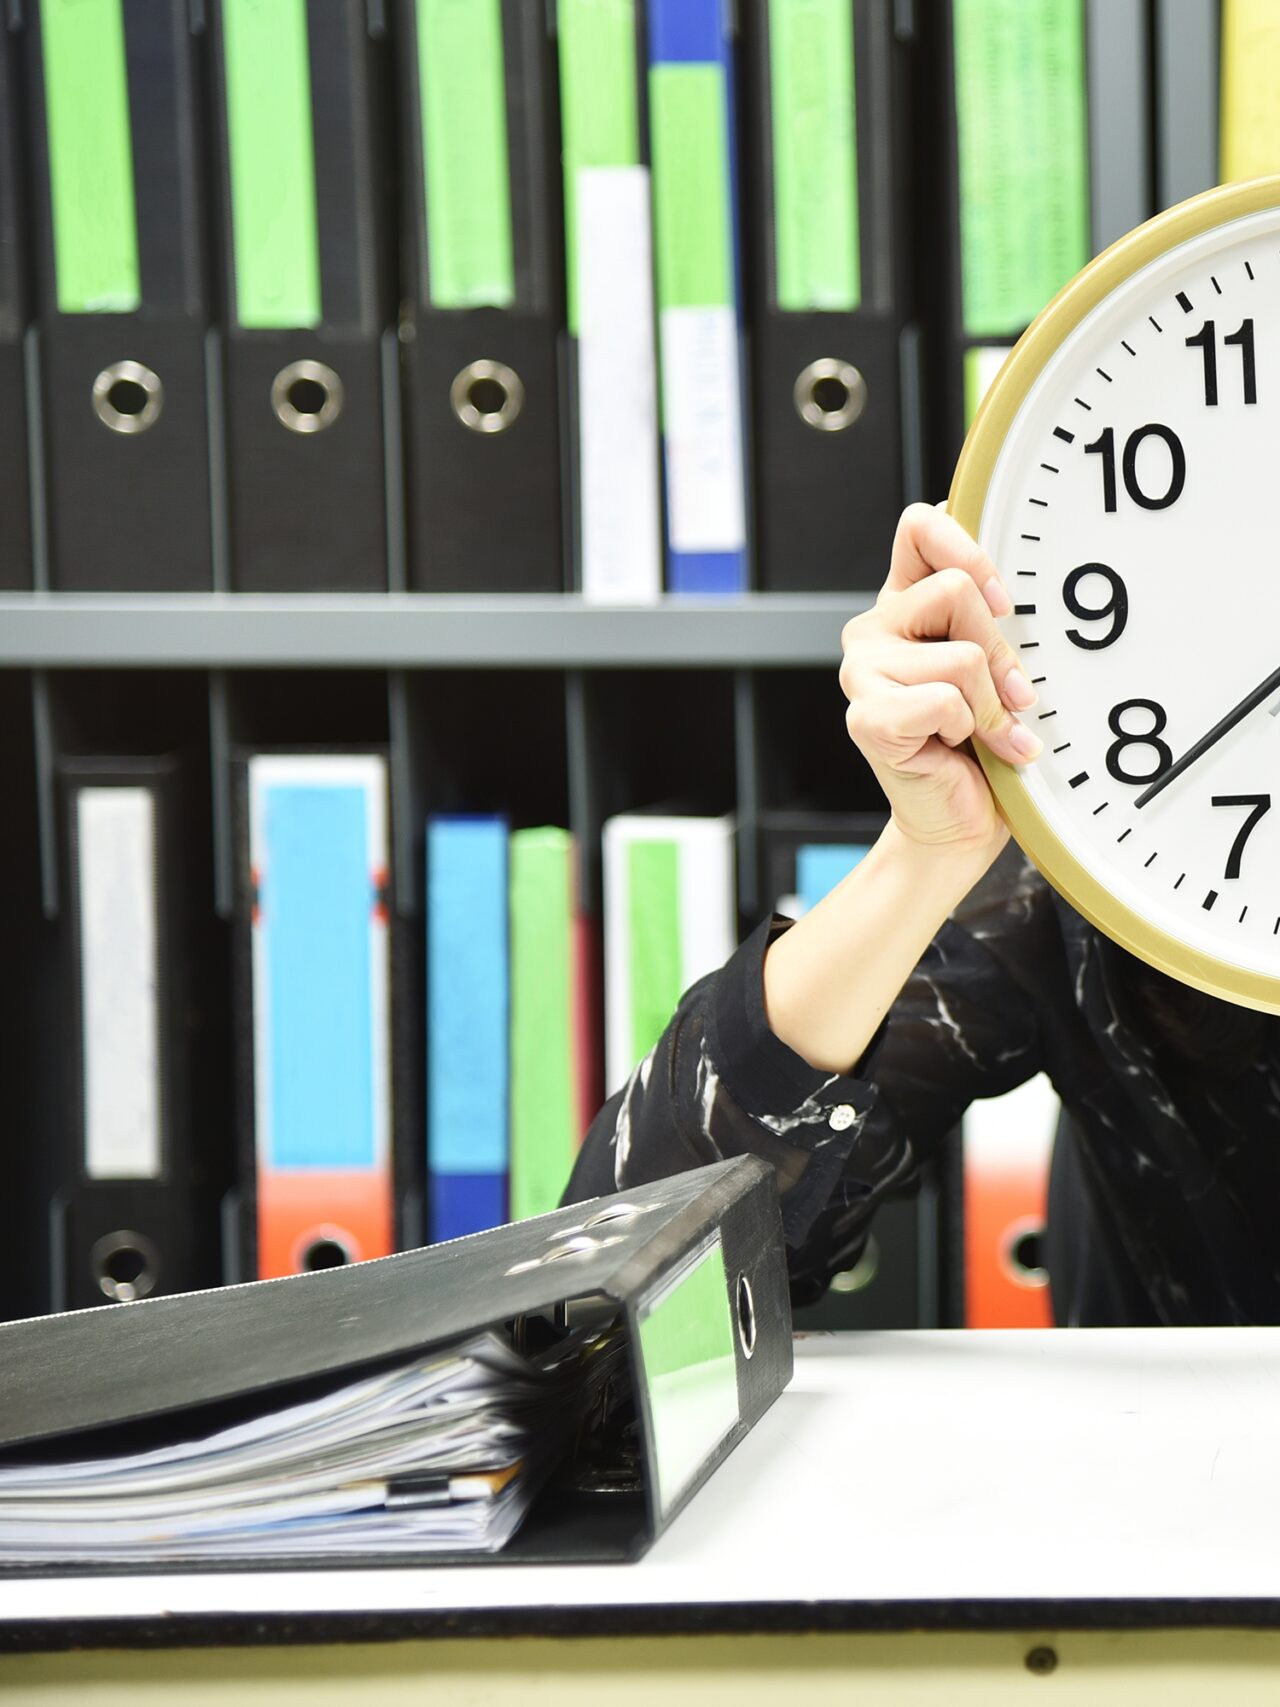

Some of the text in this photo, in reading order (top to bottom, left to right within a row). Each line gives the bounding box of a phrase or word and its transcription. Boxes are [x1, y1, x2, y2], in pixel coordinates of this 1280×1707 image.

[1186, 319, 1257, 407] 11
[1085, 424, 1186, 514] 10
[1063, 563, 1129, 651] 9
[1105, 698, 1174, 785] 8
[1212, 794, 1271, 880] 7
